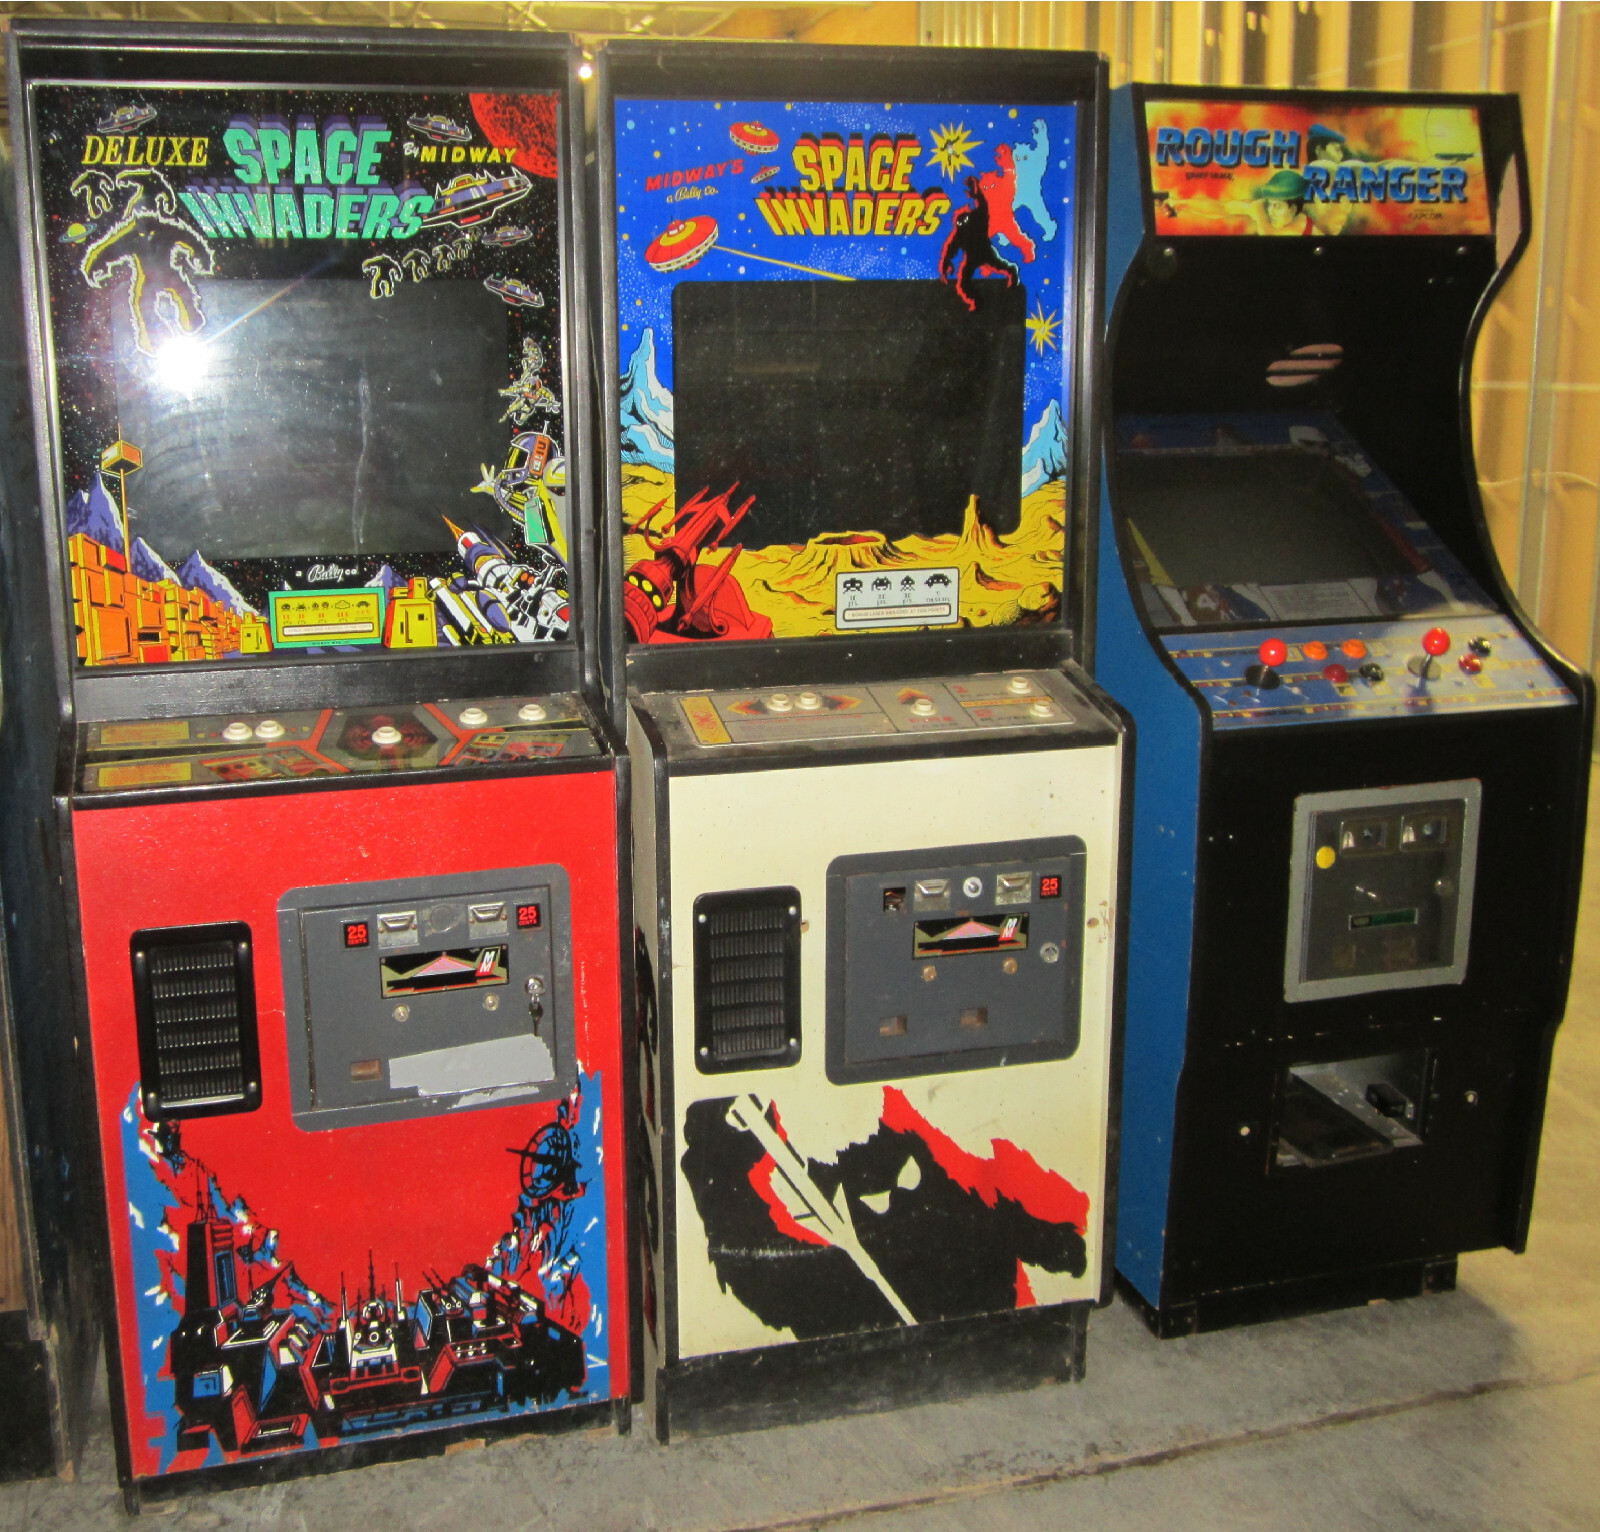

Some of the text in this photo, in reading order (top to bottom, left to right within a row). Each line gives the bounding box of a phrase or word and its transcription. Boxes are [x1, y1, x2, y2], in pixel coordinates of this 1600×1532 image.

[81, 135, 209, 167] DELUXE
[222, 126, 392, 185] SPACE
[403, 141, 517, 163] By MIDWAY
[1155, 126, 1302, 168] ROUGH
[645, 158, 745, 192] MIDWAY'S
[791, 144, 922, 192] SPACE
[1303, 164, 1469, 204] RANGER
[674, 186, 703, 202] Bally
[176, 190, 436, 239] INVADERS
[755, 196, 951, 236] INVADERS
[307, 563, 344, 583] Bally
[1042, 877, 1058, 891] 25
[518, 905, 537, 920] 25
[347, 924, 367, 940] 25
